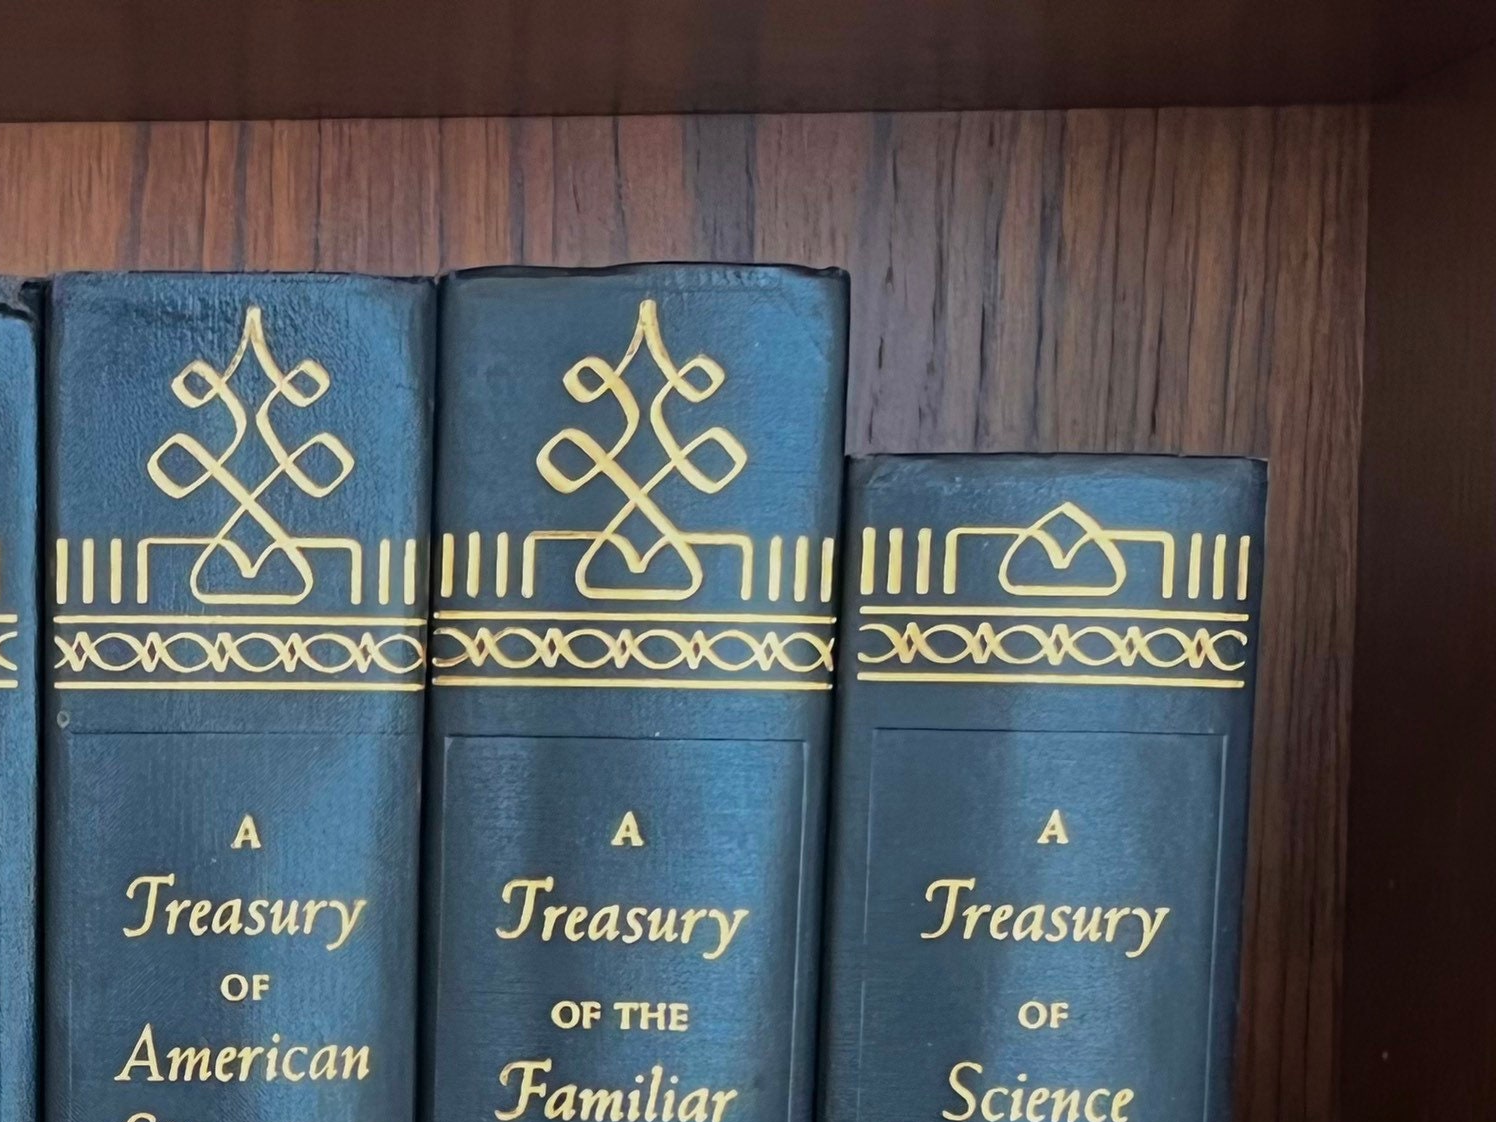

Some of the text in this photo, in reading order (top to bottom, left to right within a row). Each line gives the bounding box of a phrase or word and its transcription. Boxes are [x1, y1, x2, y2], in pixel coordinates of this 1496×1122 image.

[233, 815, 261, 849] A
[612, 812, 645, 847] A
[1039, 812, 1068, 844] A
[125, 873, 367, 949] Treasury
[498, 876, 748, 960] Treasury
[922, 878, 1169, 958] Treasury
[221, 973, 270, 1002] OF
[551, 1000, 688, 1031] OF THE
[1019, 1001, 1067, 1028] OF
[113, 1024, 371, 1082] American
